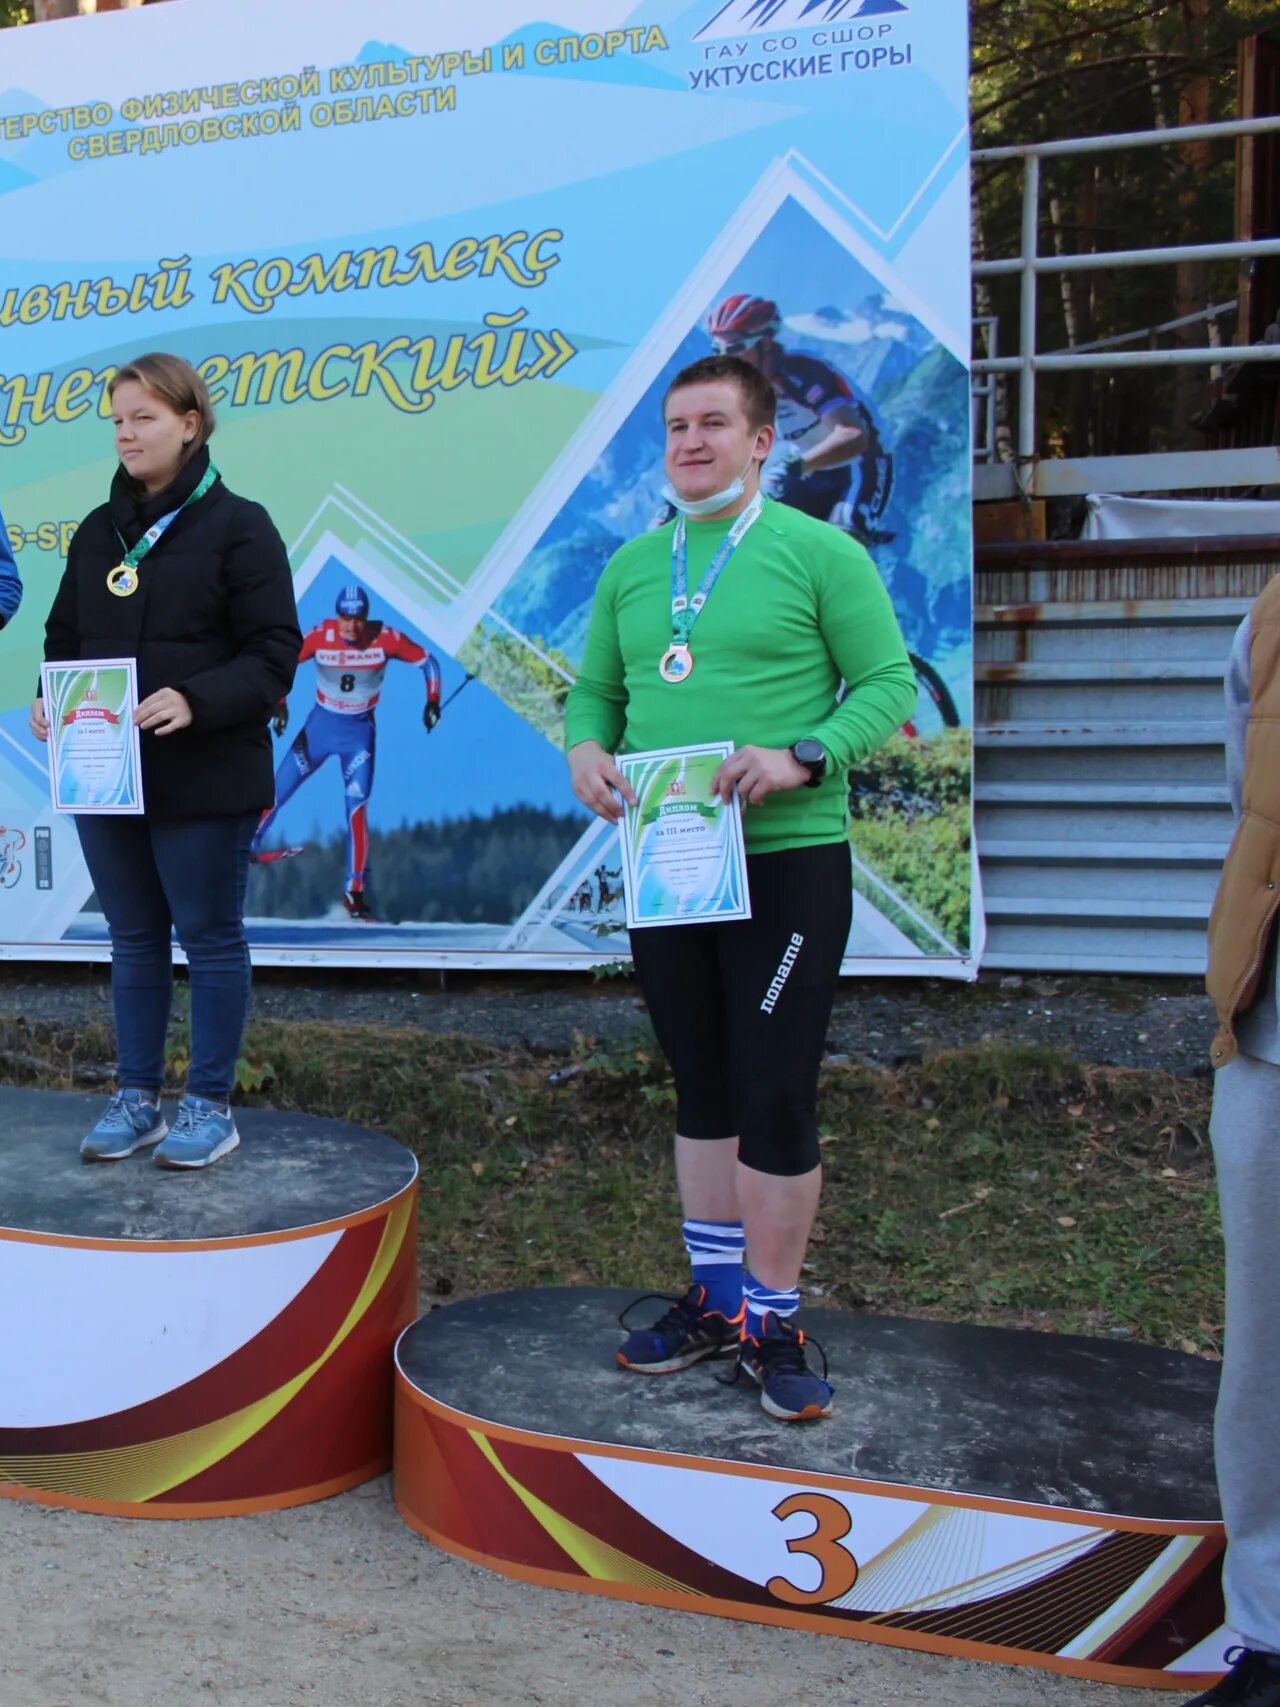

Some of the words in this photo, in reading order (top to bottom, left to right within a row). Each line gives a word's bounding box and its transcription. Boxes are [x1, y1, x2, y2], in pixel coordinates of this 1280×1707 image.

[688, 53, 833, 90] УКТУССКИЕ
[841, 43, 912, 72] ГОРЫ
[704, 43, 748, 60] ГАУ
[762, 37, 798, 53] СО
[812, 24, 892, 46] СШОР
[120, 65, 320, 121] ФИЗИЧЕСКОЙ
[329, 46, 492, 94] КУЛЬТУРЫ
[502, 43, 525, 71] И
[534, 25, 669, 66] СПОРТА
[67, 101, 302, 161] СВЕРДЛОВСКОЙ
[310, 85, 457, 128] ОБЛАСТИ
[210, 228, 564, 314] комплекс
[340, 674, 356, 693] 8
[659, 804, 698, 817] Диплом
[680, 826, 706, 834] место
[760, 931, 804, 1016] noname
[765, 1491, 859, 1605] 3
